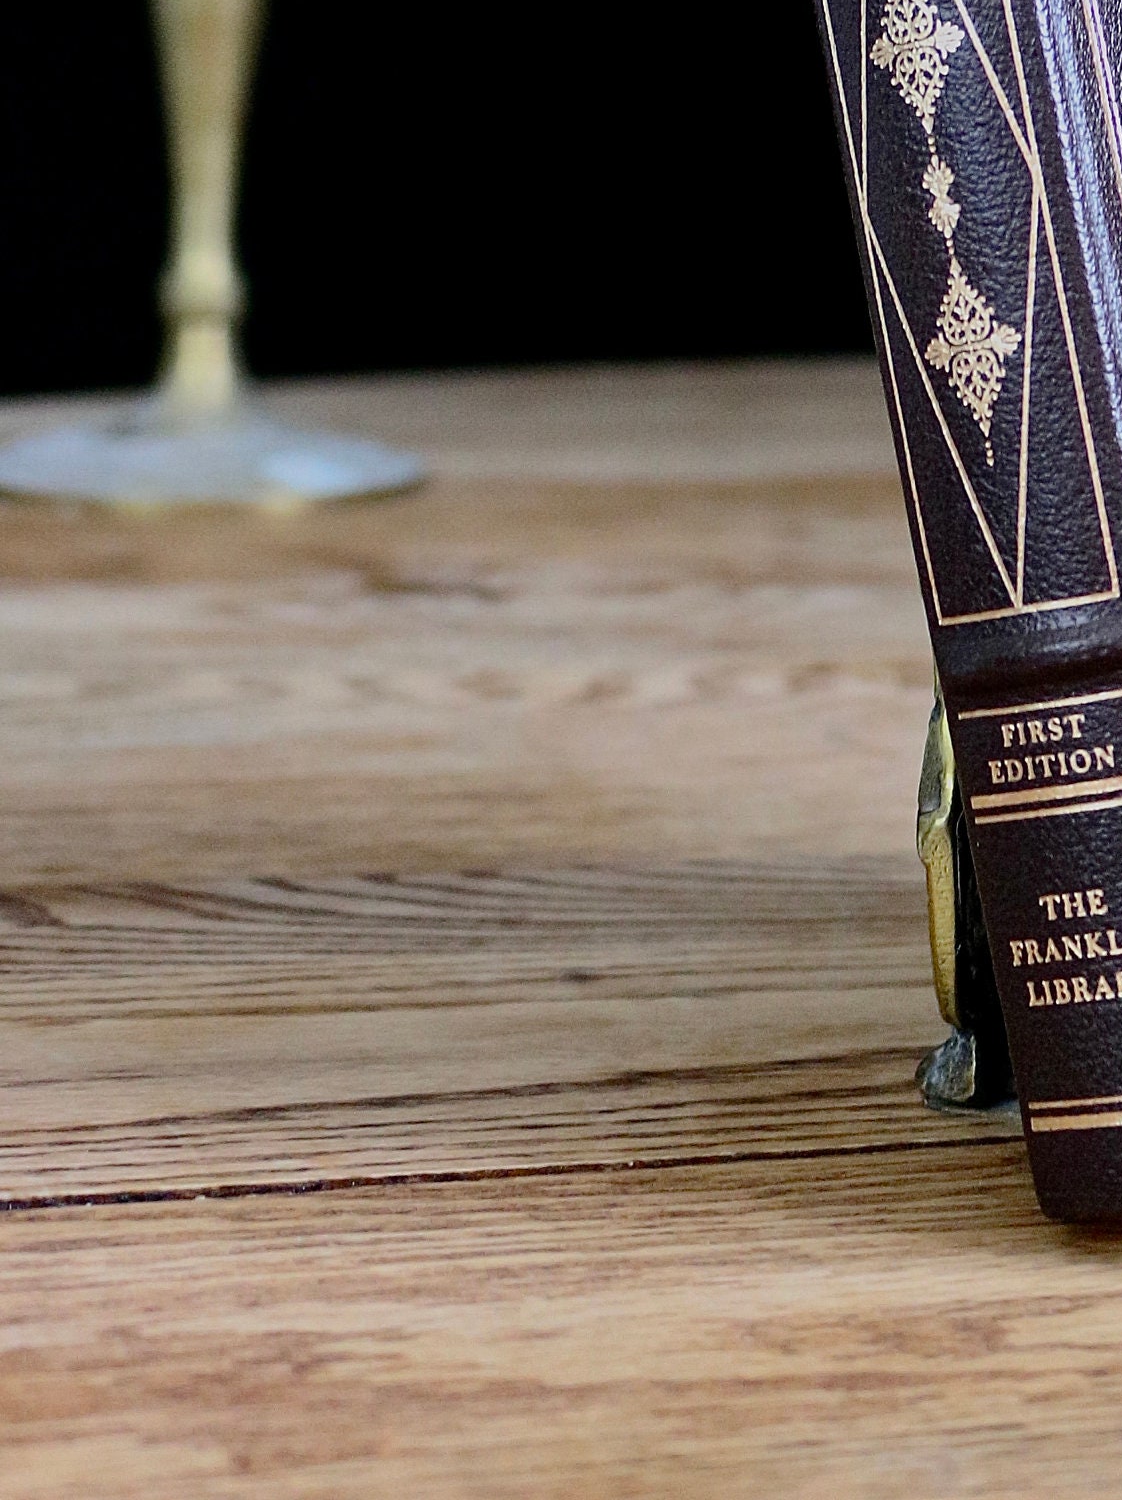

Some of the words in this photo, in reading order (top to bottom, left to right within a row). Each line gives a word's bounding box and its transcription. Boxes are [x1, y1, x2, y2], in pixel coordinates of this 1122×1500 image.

[1001, 713, 1086, 748] FIRST
[988, 744, 1115, 784] EDITION
[1039, 888, 1109, 921] THE
